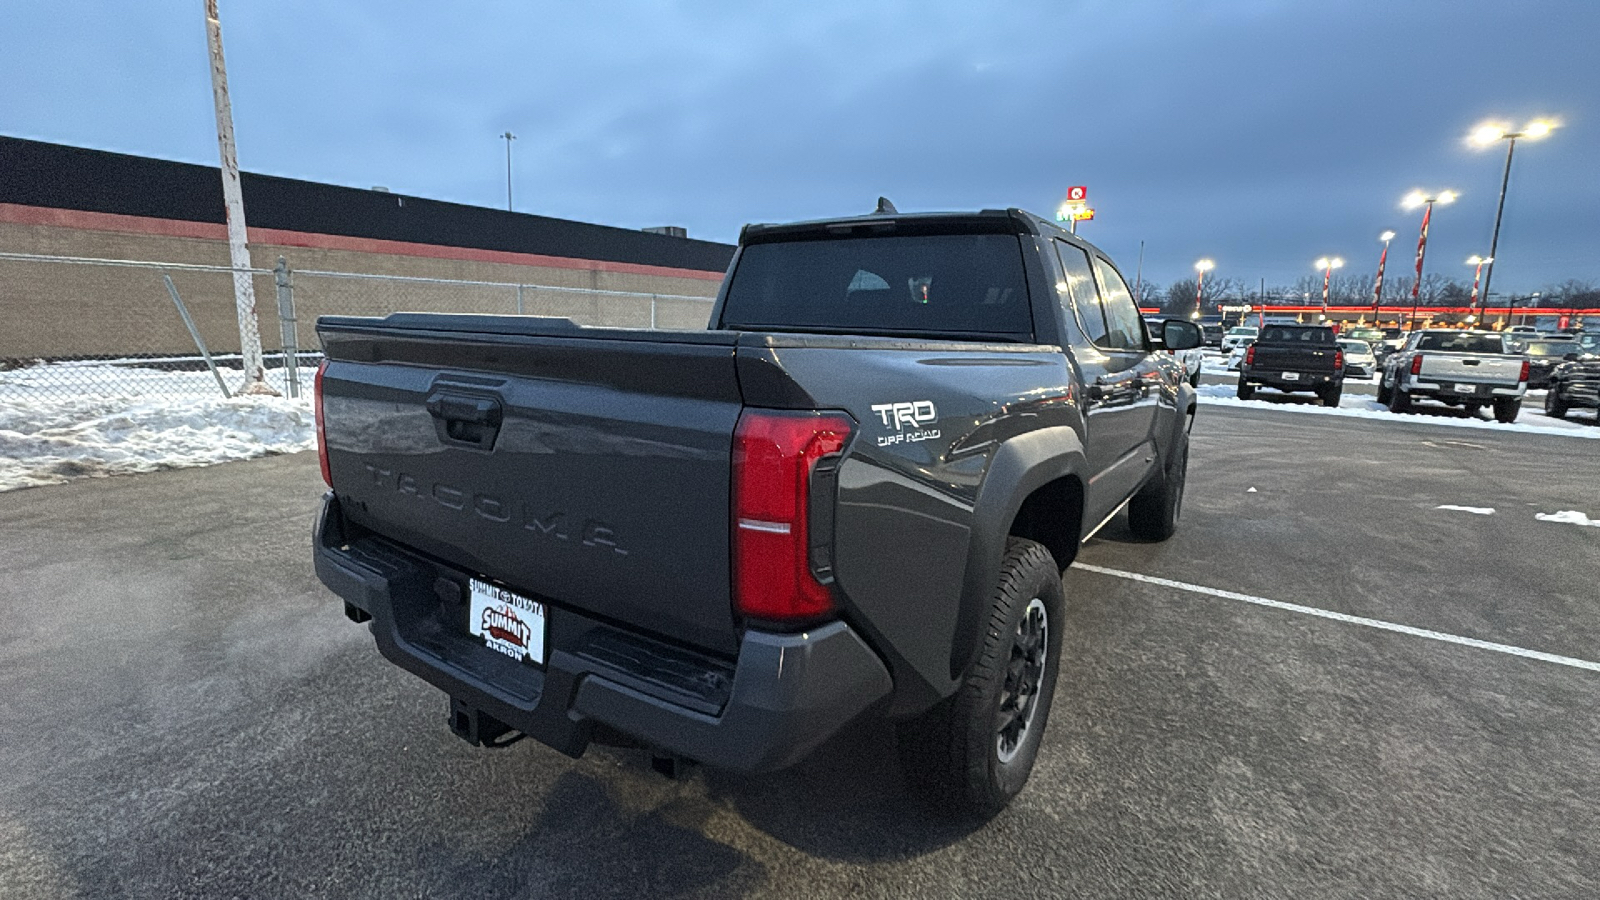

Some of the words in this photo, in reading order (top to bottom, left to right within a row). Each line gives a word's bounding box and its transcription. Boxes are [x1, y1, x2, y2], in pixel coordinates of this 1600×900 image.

[871, 401, 937, 431] TRD
[877, 434, 904, 447] OFF
[906, 429, 941, 443] ROAD
[366, 463, 629, 555] TACOMA
[469, 578, 500, 600] SUMMIT
[511, 593, 545, 617] TOYOTA
[482, 608, 530, 648] SUMMIT
[486, 639, 523, 662] AKRON
